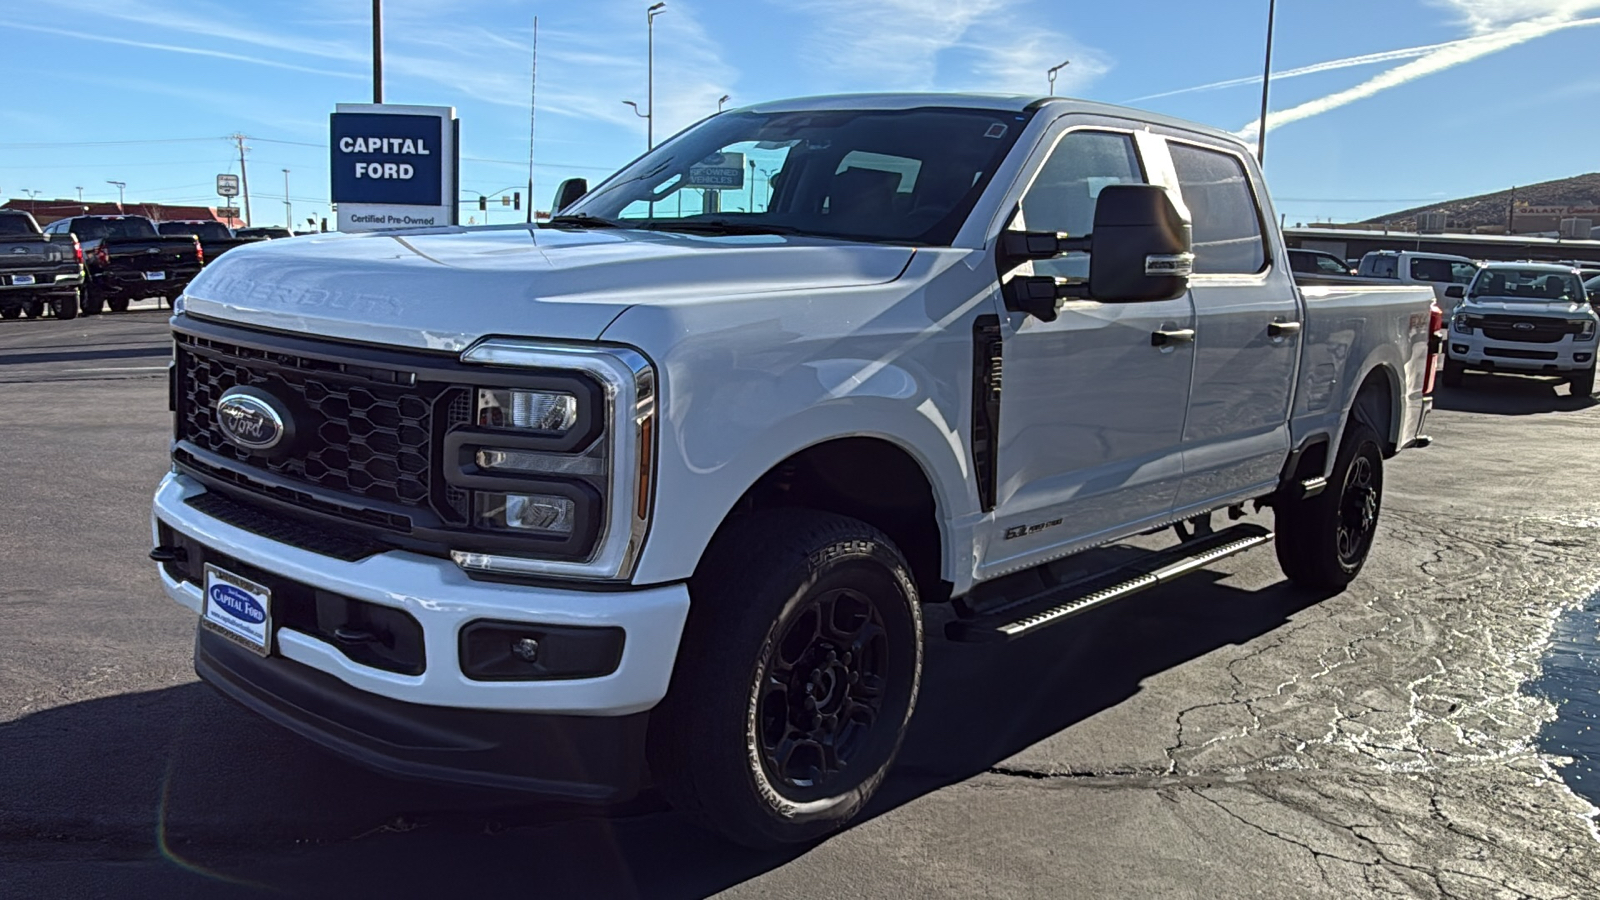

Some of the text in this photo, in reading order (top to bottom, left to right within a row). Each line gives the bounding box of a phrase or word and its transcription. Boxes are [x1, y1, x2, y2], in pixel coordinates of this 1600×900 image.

[339, 137, 430, 155] CAPITAL
[355, 162, 414, 179] FORD
[688, 168, 739, 177] RE-OWNED
[690, 176, 733, 184] VEHICLES
[350, 214, 435, 226] Certified Pre-Owned
[213, 588, 243, 613] CAPITAL
[244, 602, 264, 621] FORD
